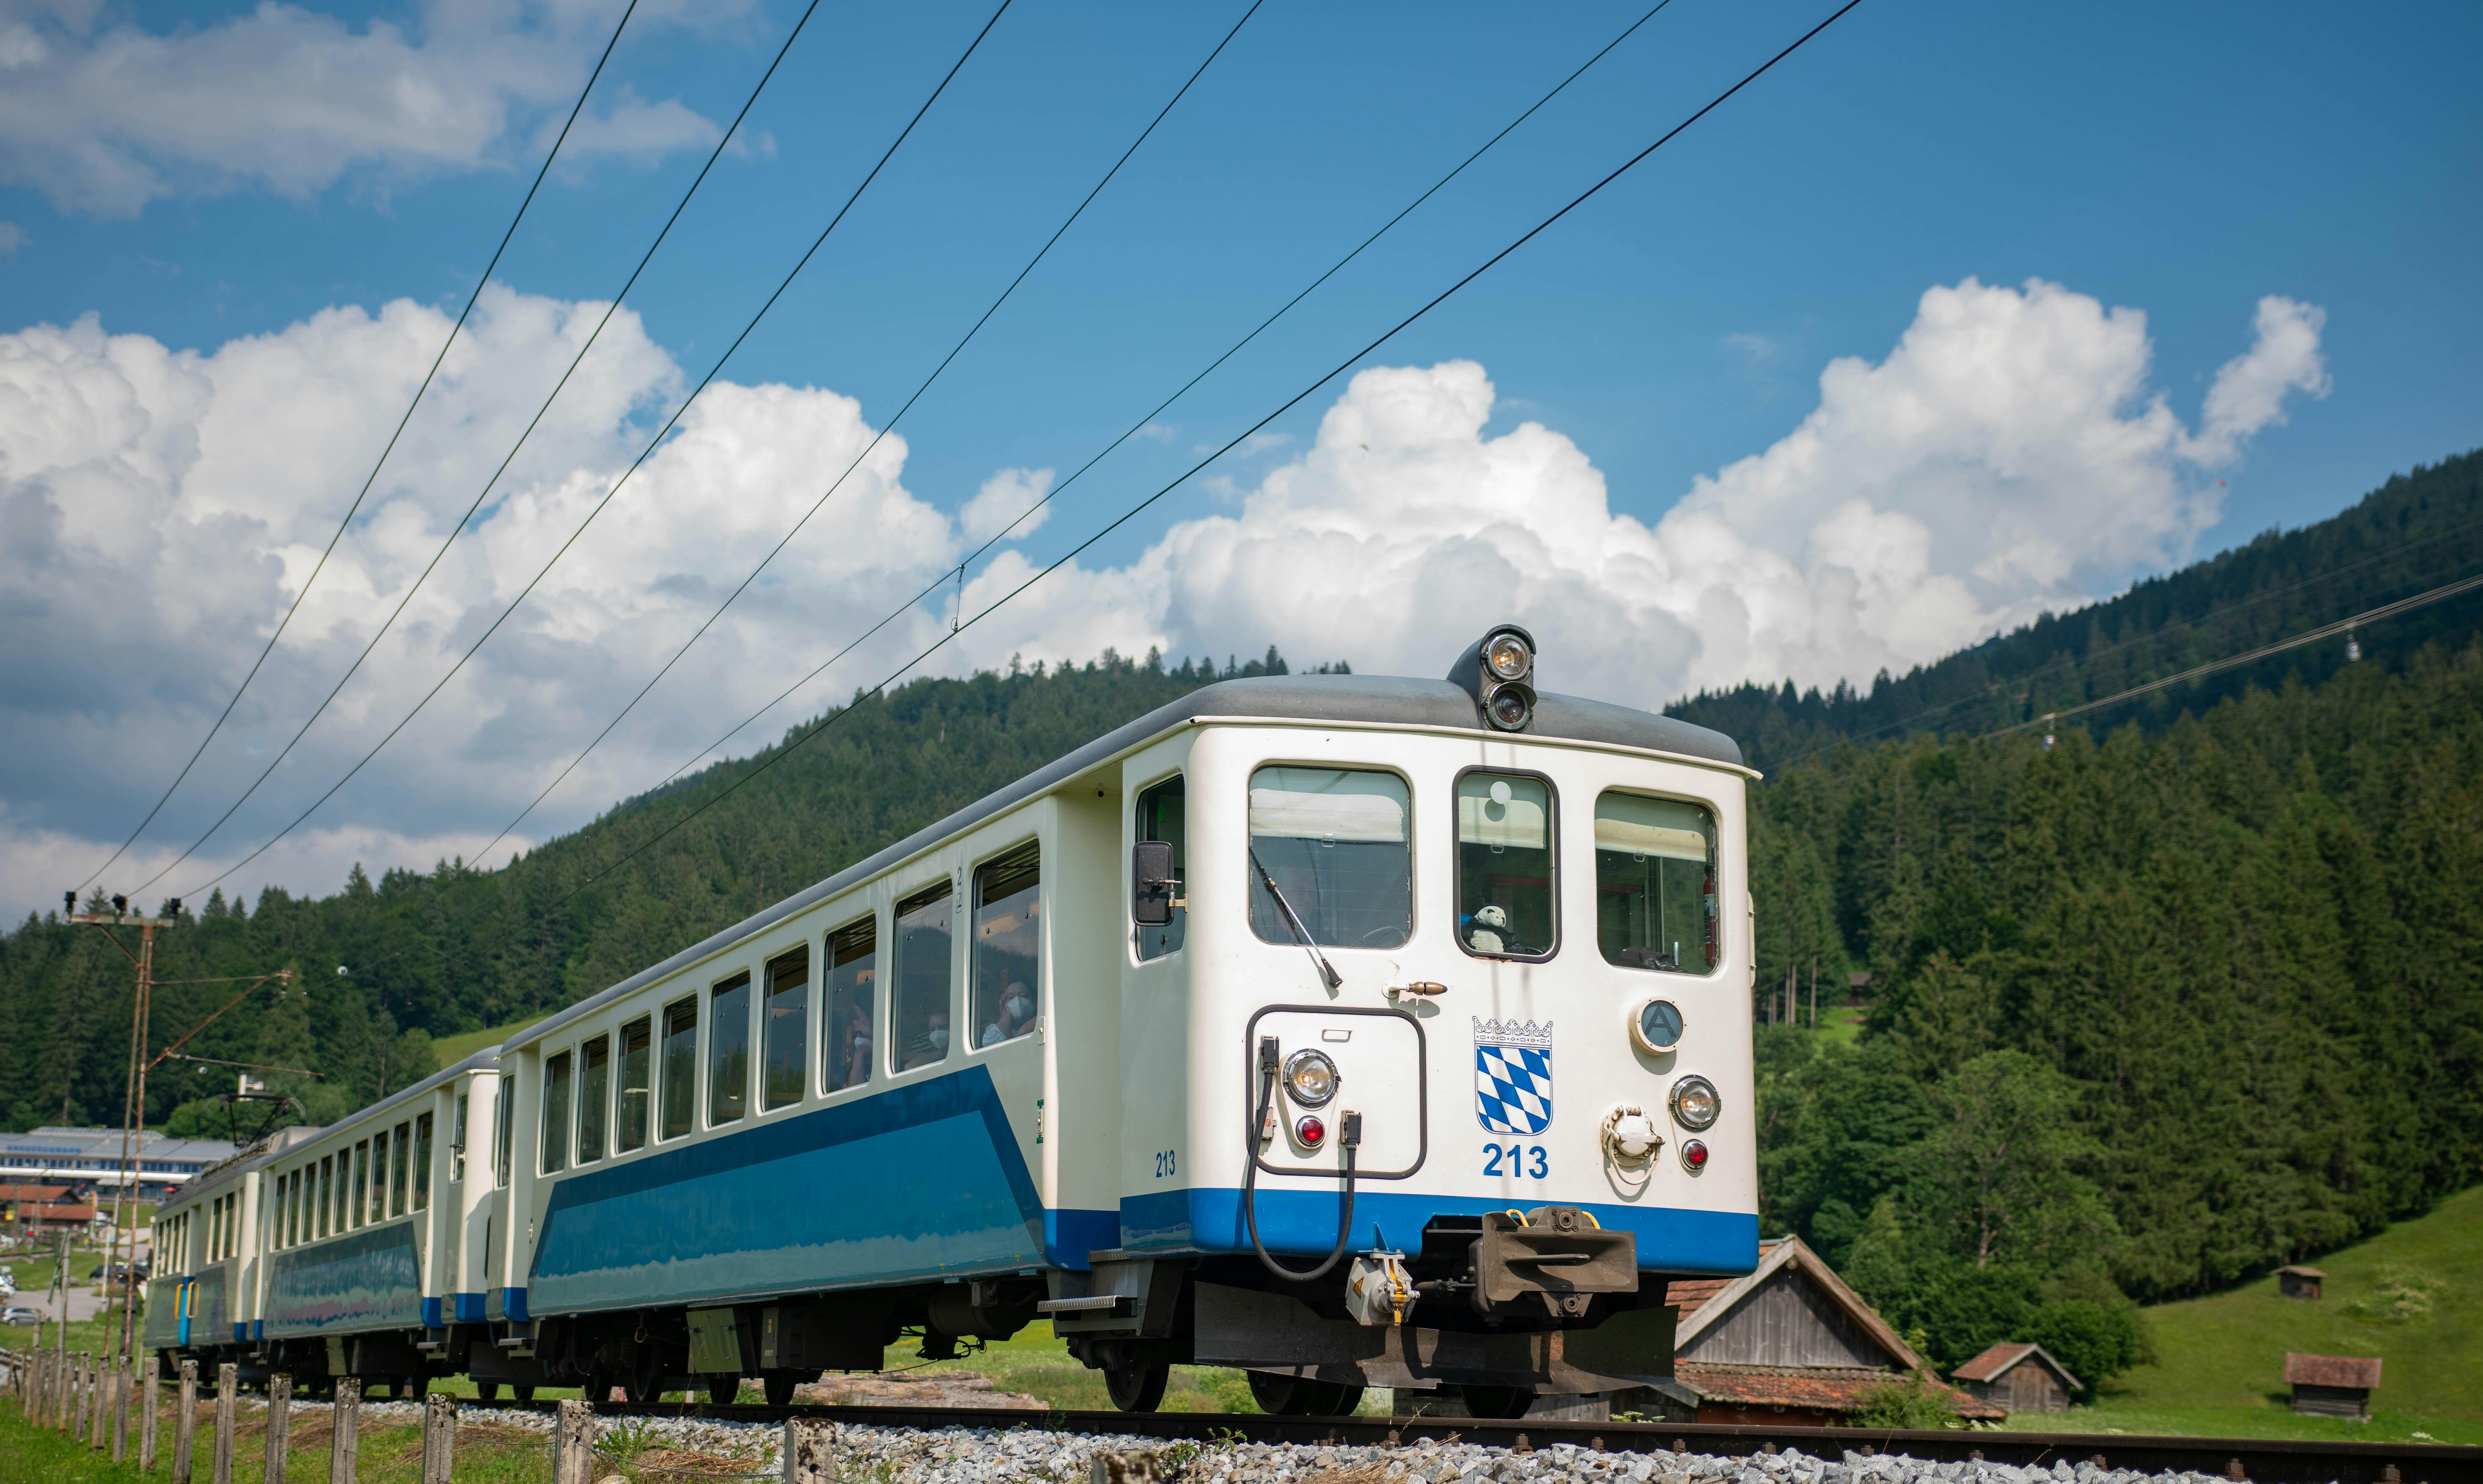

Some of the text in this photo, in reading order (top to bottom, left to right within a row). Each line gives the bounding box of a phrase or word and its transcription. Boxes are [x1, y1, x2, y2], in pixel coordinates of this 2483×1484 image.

[957, 867, 961, 886] 2
[1644, 1005, 1676, 1037] A
[1156, 1149, 1175, 1178] 213
[1483, 1143, 1548, 1179] 213
